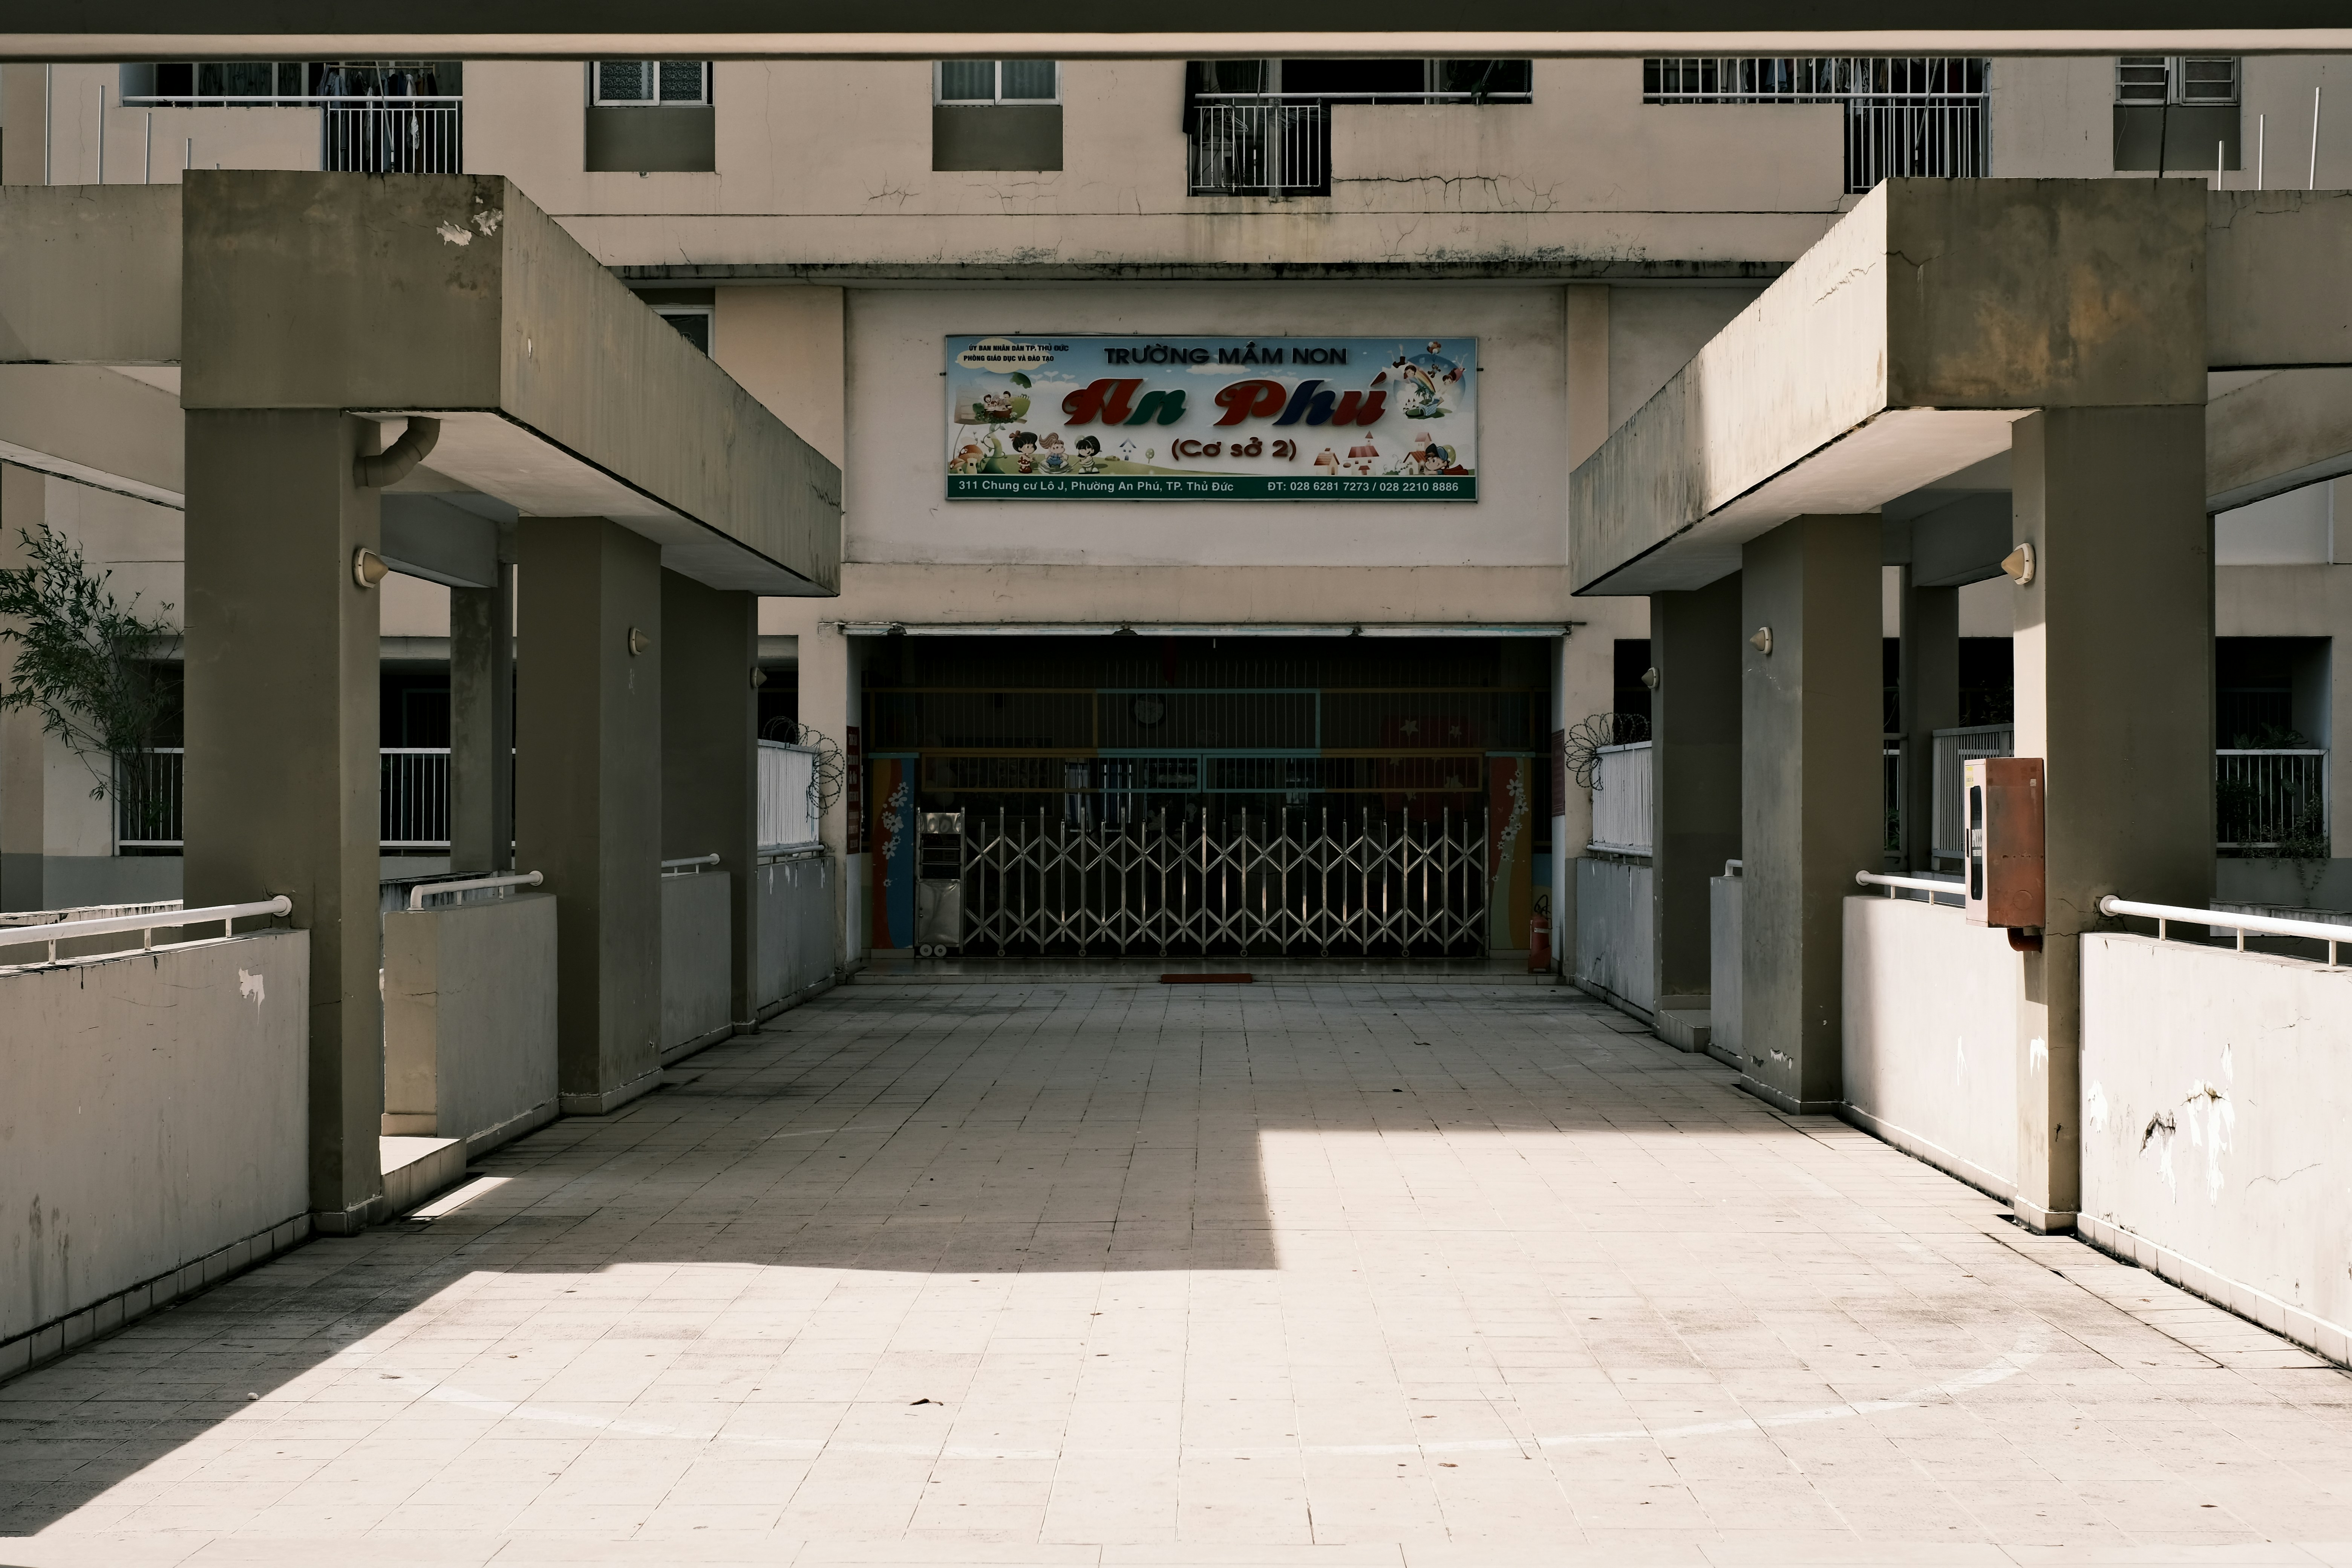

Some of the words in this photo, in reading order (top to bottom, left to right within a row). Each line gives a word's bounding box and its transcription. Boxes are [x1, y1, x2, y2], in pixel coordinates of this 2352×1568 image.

[1104, 343, 1210, 364] TRƯỜNG
[1292, 348, 1347, 364] NON
[1061, 378, 1187, 426] An
[1213, 371, 1388, 426] Phú
[1171, 438, 1222, 461] (Cơ
[1230, 436, 1263, 457] sở
[1272, 438, 1297, 461] 2)
[959, 481, 977, 490] 311
[982, 481, 1019, 492] Chung
[1040, 481, 1055, 490] Lô
[1058, 481, 1067, 492] J,
[1071, 481, 1115, 492] Phường
[1118, 481, 1133, 490] An
[1137, 481, 1162, 492] Phú,
[1166, 482, 1183, 490] TP.
[1187, 481, 1208, 491] Thủ
[1212, 482, 1234, 491] Đức
[1268, 482, 1286, 490] ĐT:
[1290, 482, 1310, 490] 028
[1313, 482, 1338, 491] 6281
[1343, 482, 1369, 491] 7273
[1372, 482, 1376, 491] /
[1380, 482, 1399, 491] 028
[1403, 482, 1429, 491] 2210
[1432, 482, 1458, 491] 8886
